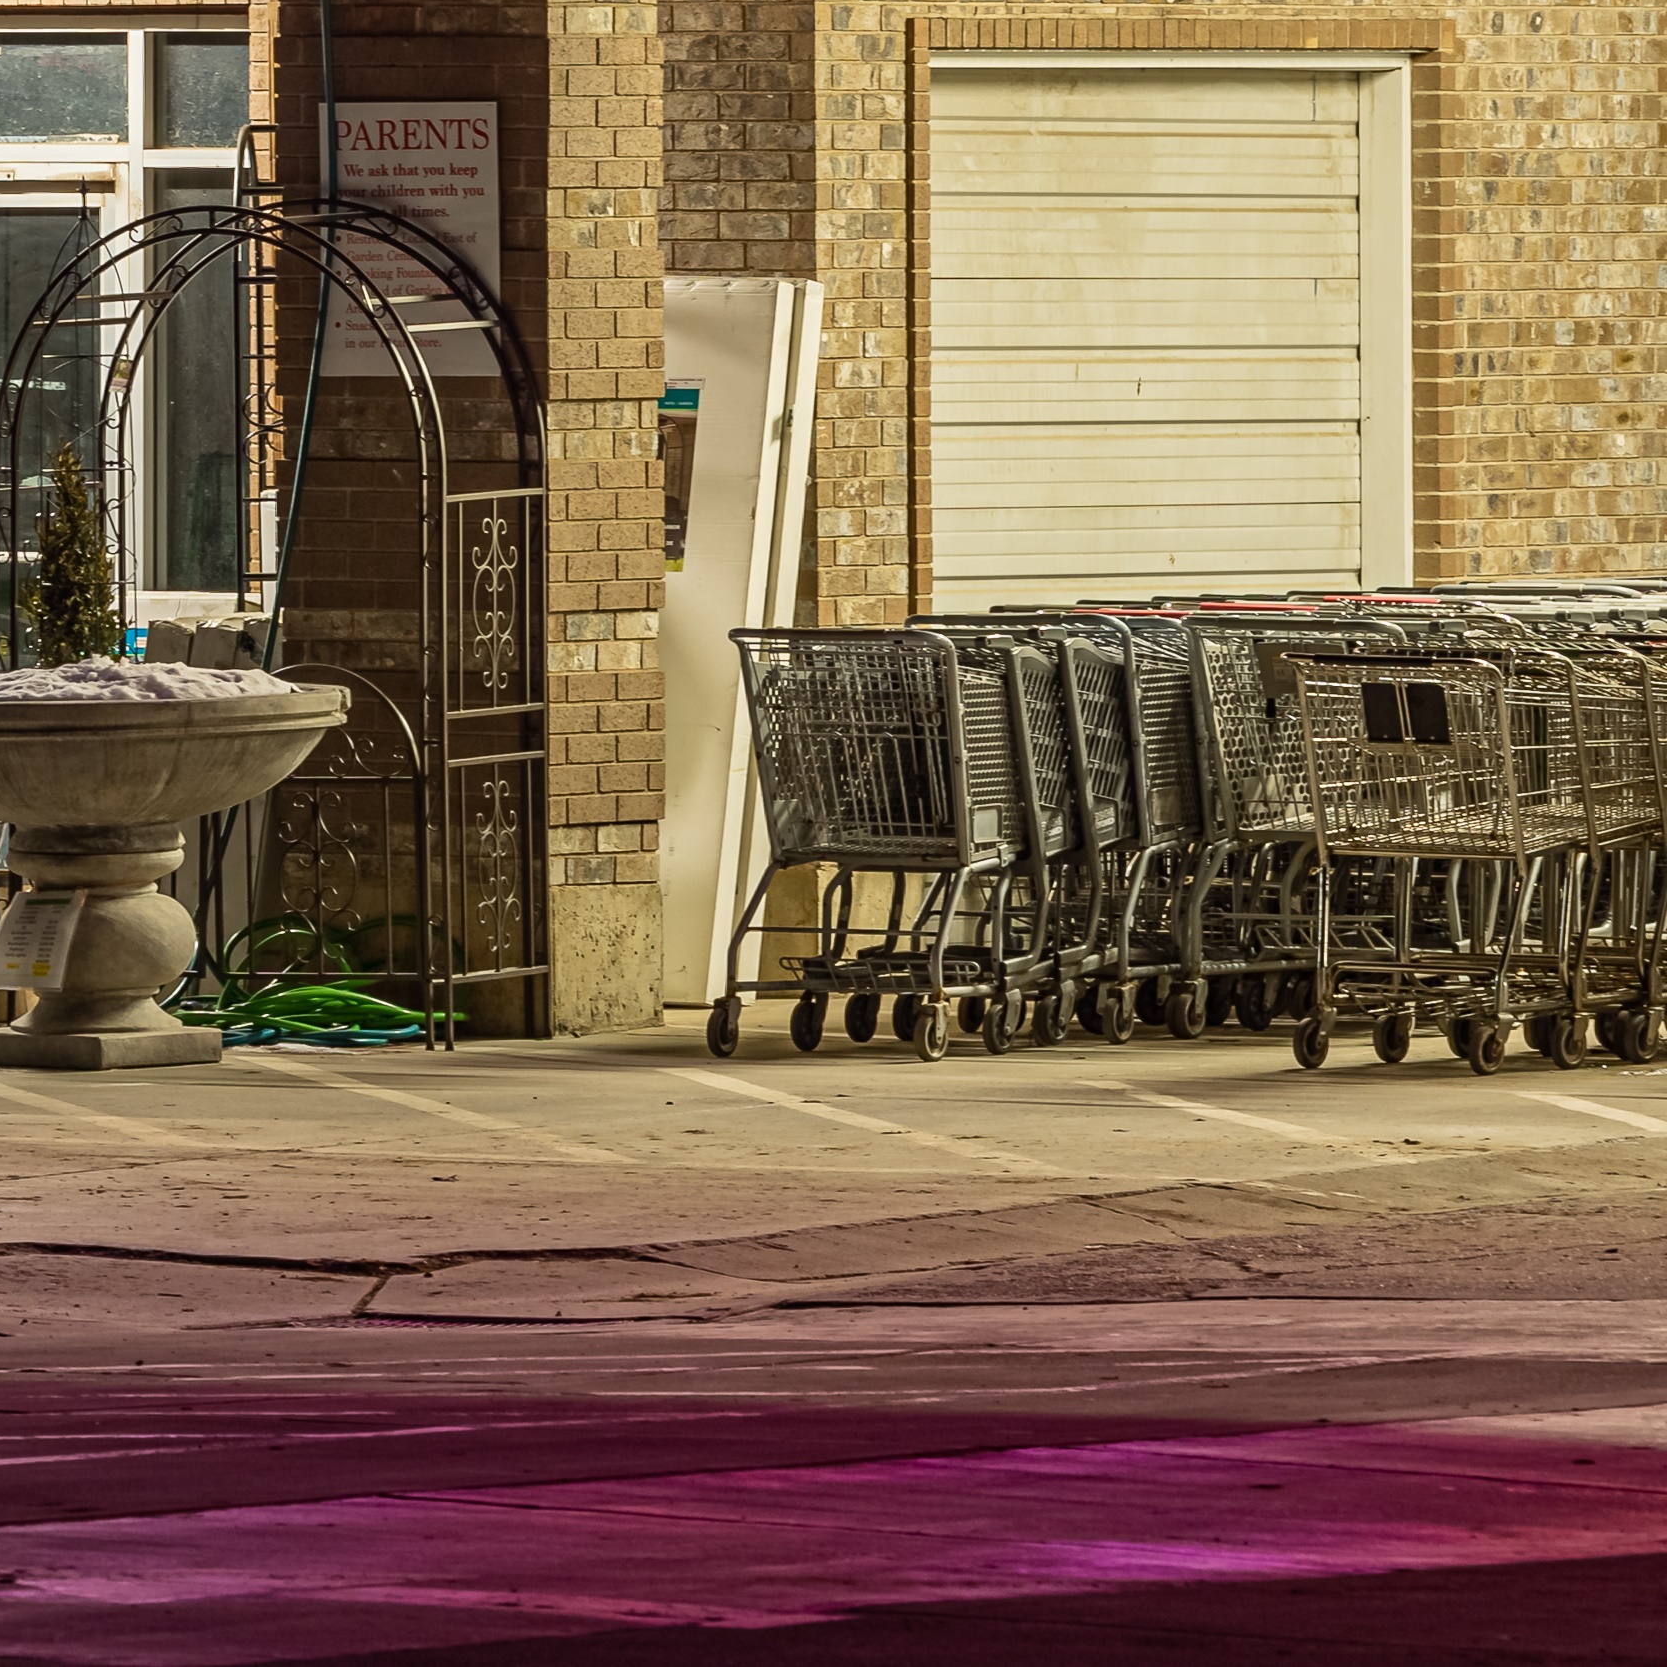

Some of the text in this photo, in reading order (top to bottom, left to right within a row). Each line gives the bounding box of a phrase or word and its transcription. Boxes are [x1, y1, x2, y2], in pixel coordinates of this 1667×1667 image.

[335, 117, 490, 152] PARENTS
[344, 163, 479, 179] We ask that you keep
[337, 184, 485, 200] your children with you
[390, 205, 450, 218] all times.
[442, 231, 464, 244] East
[466, 231, 478, 243] of
[345, 337, 356, 349] in
[358, 340, 377, 349] our
